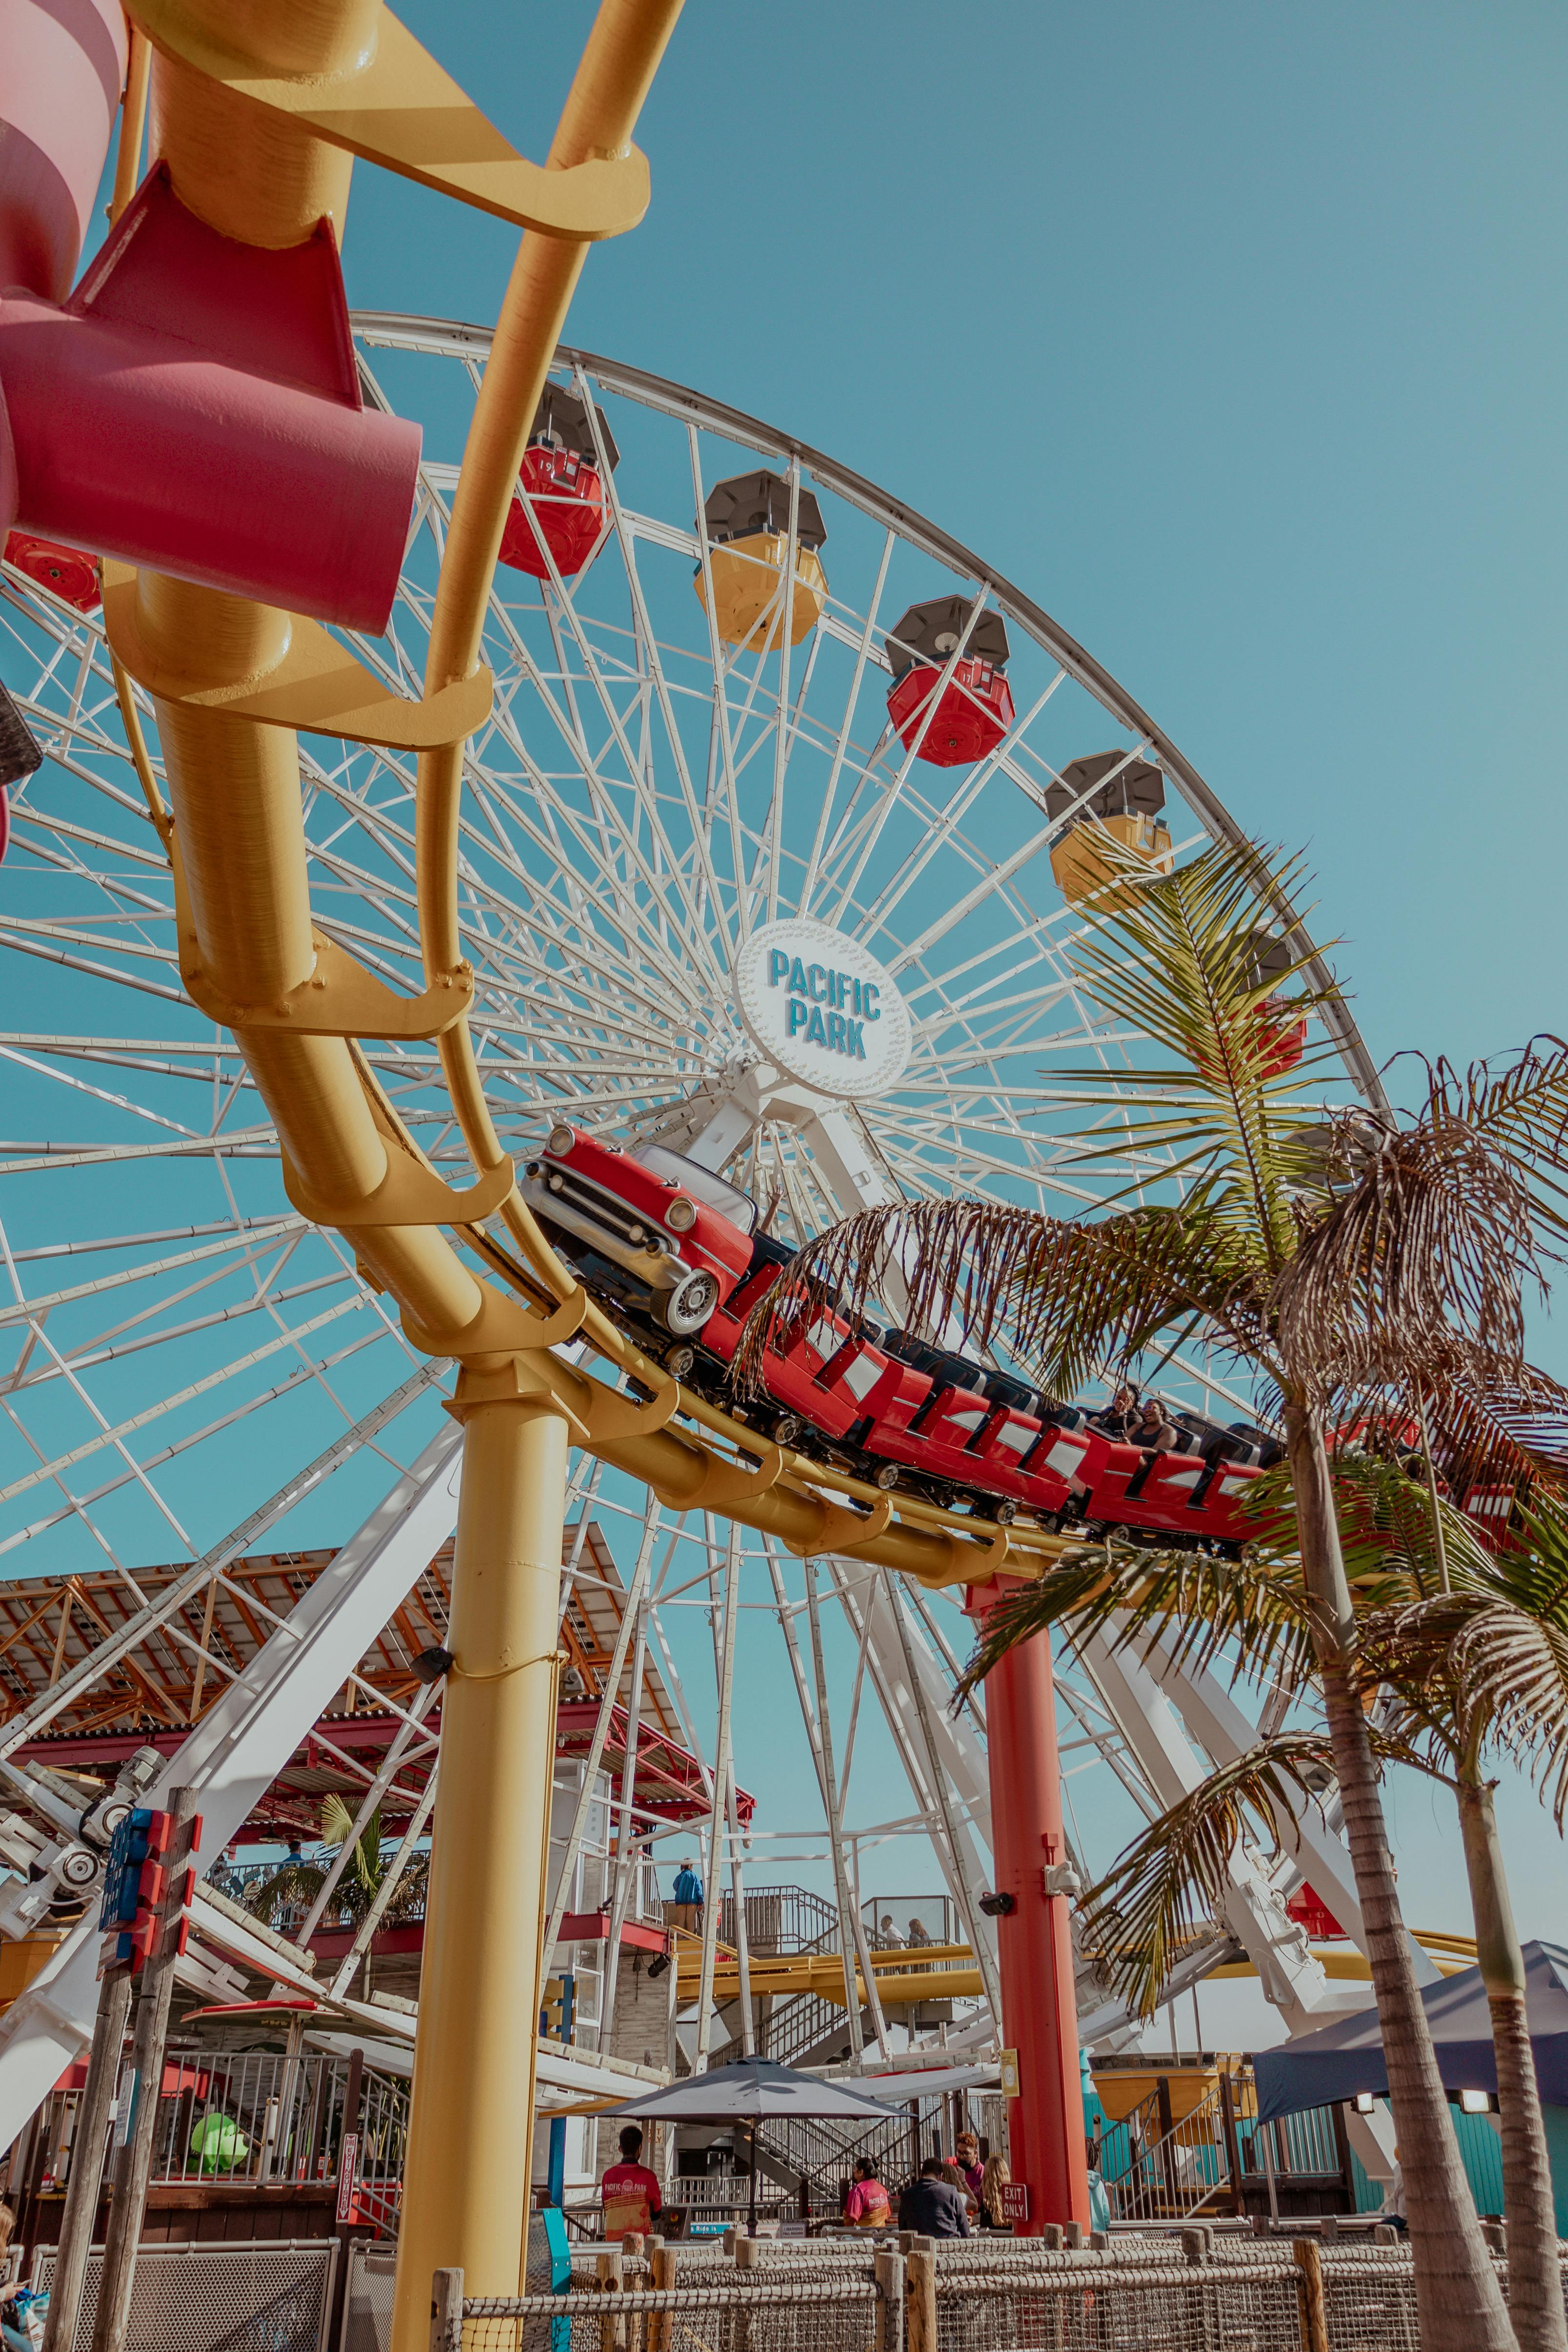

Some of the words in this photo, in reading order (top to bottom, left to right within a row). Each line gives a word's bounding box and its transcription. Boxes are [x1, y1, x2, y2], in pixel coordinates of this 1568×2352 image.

[540, 460, 552, 472] 19
[962, 673, 971, 684] 17
[1159, 842, 1165, 852] 16
[772, 948, 880, 1021] PACIFIC
[790, 997, 867, 1059] PARK
[342, 2148, 352, 2211] EXTINGUISHER
[605, 2183, 621, 2191] PACIFIC
[634, 2183, 647, 2192] PARK
[1004, 2186, 1021, 2201] EXIT
[1004, 2202, 1023, 2218] ONLY
